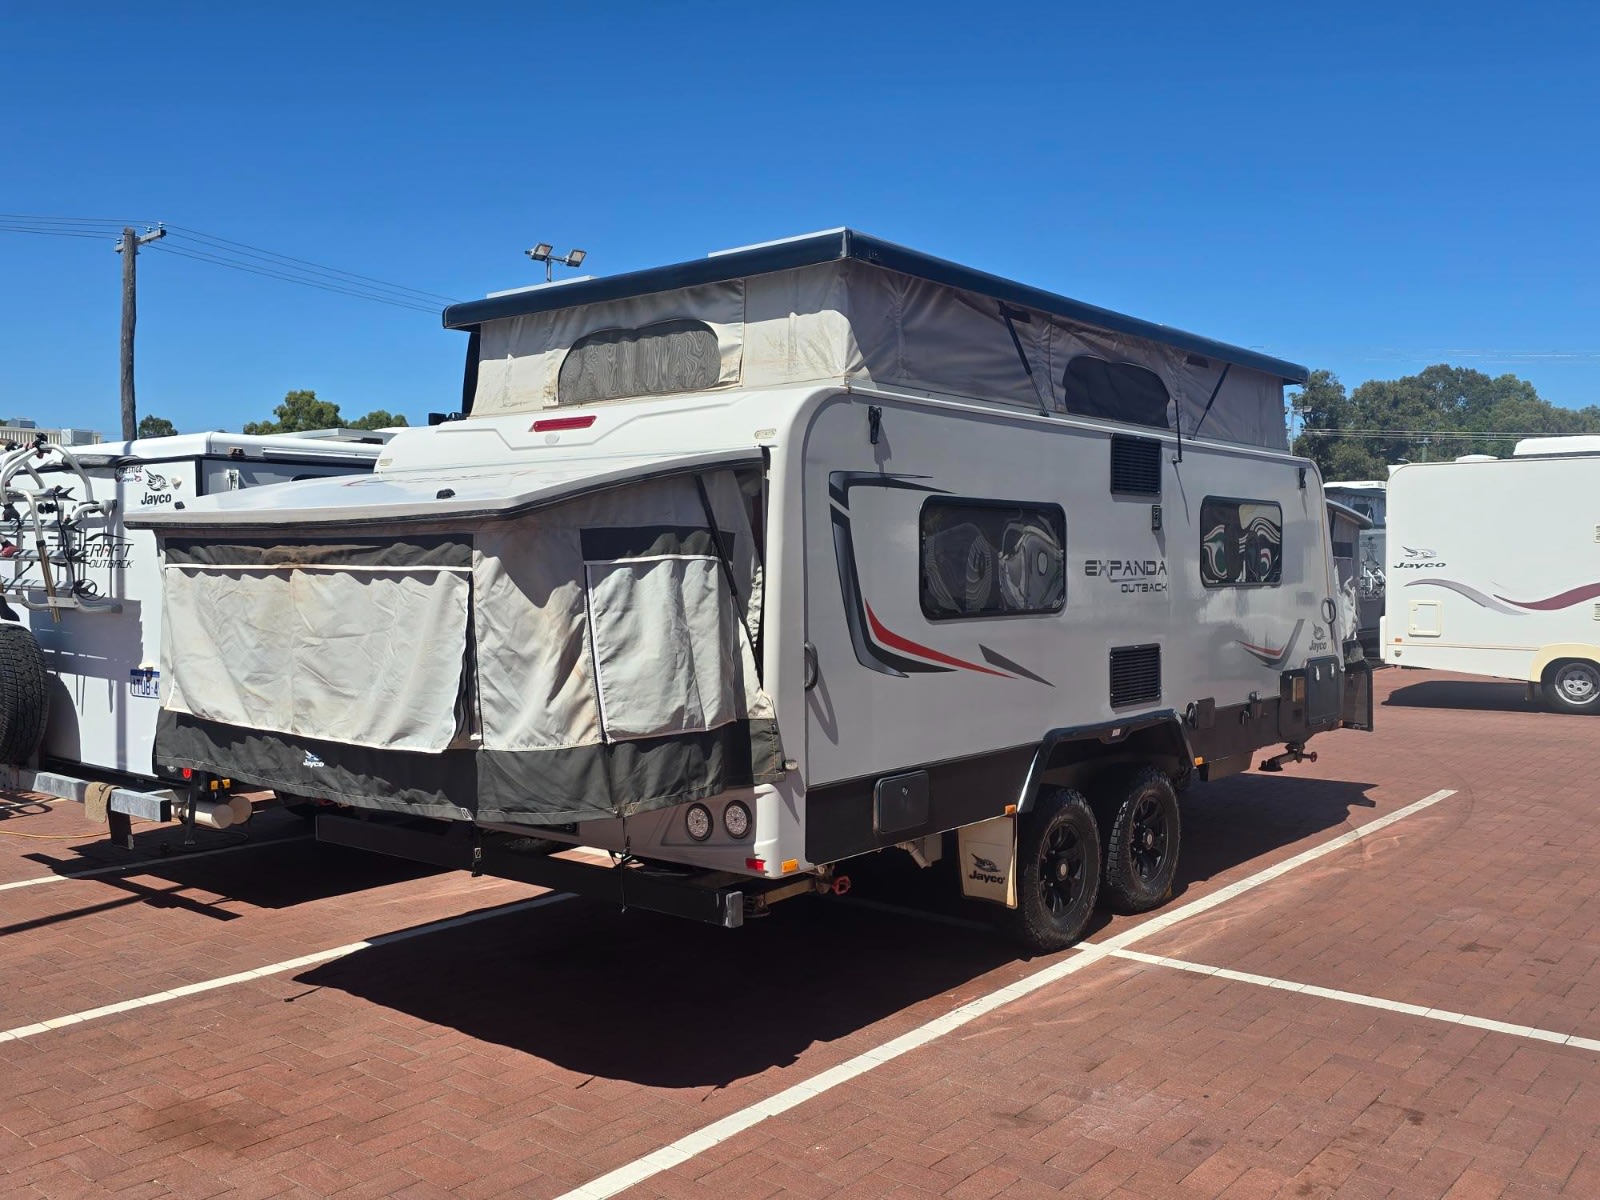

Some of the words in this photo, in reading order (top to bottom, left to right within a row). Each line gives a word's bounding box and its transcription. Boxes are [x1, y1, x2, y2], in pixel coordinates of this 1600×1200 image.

[141, 492, 172, 506] Jayco
[89, 559, 135, 569] OUTBACK
[1085, 559, 1167, 577] EXPANDA
[1121, 583, 1168, 593] OUTBACK
[1309, 639, 1327, 652] Jayco
[302, 758, 325, 768] Jayco
[969, 870, 1005, 885] Jayco
